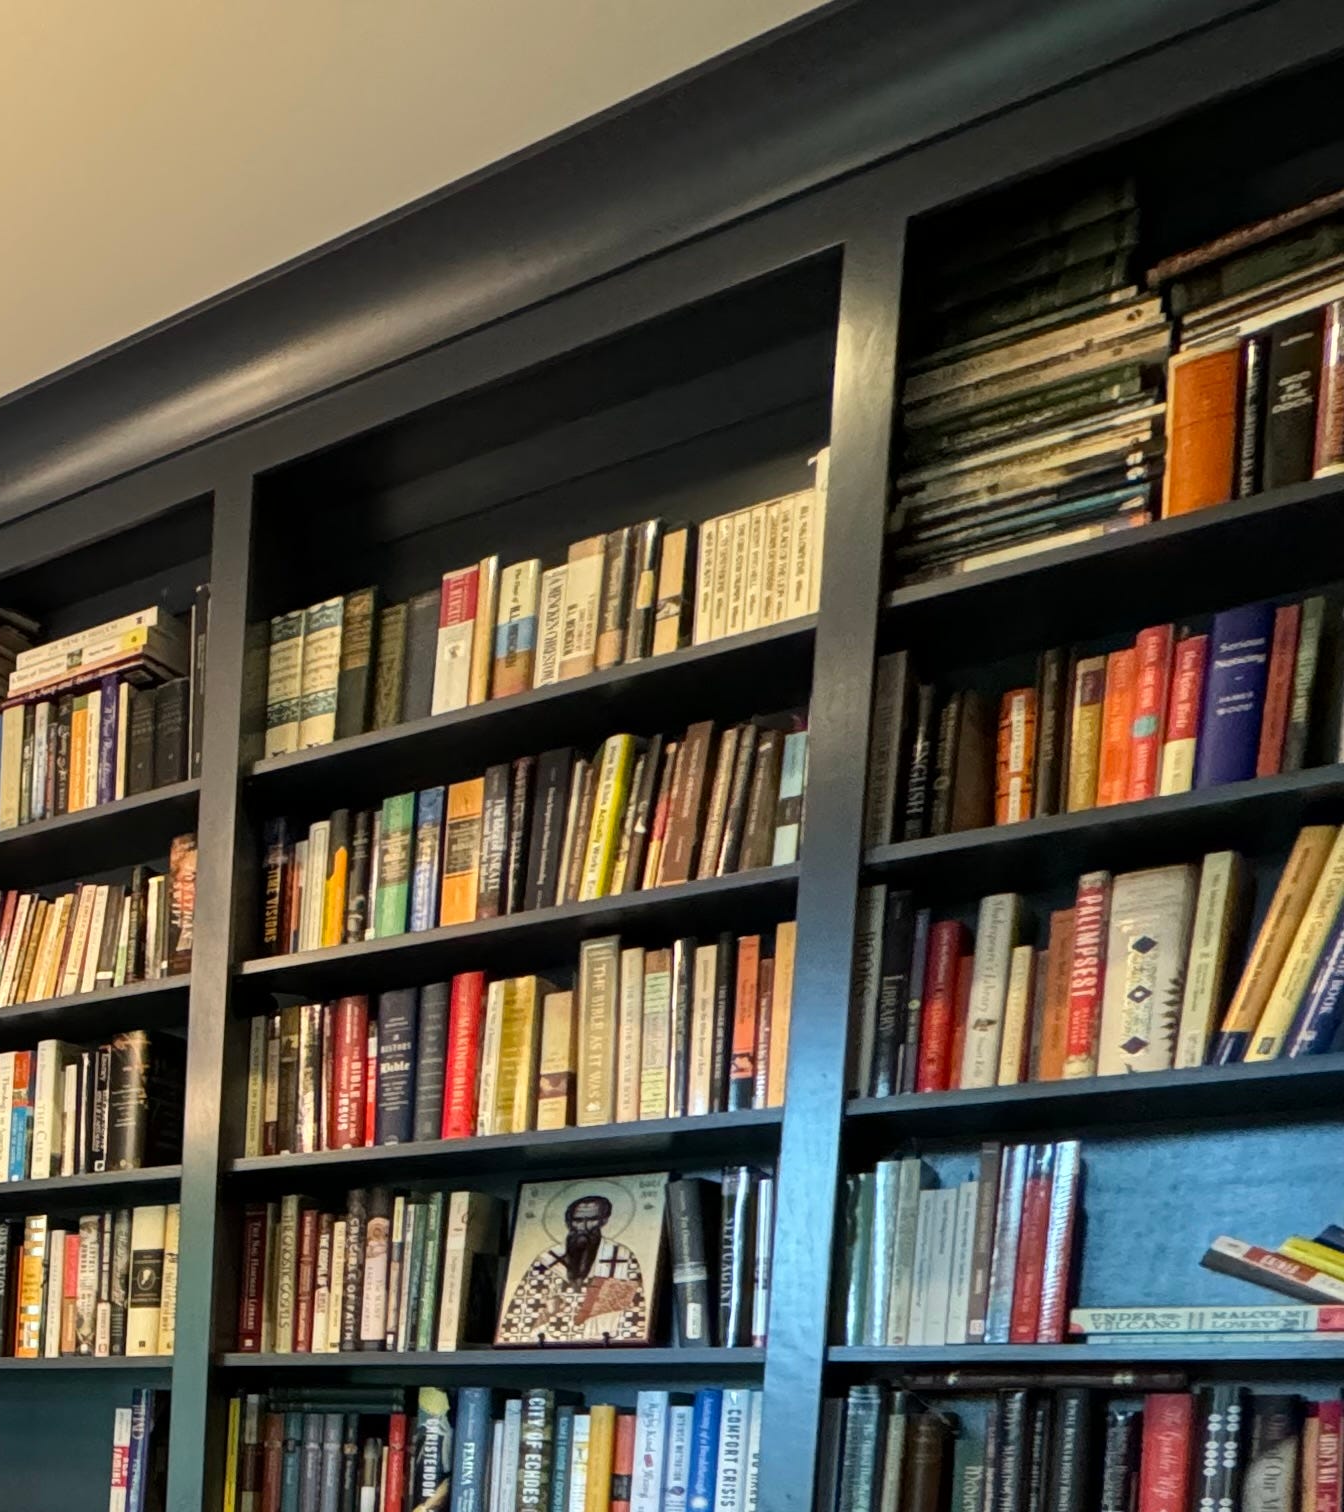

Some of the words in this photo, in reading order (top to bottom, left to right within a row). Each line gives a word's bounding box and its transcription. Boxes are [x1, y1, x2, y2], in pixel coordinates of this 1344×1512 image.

[1215, 652, 1266, 670] Noticing
[1220, 637, 1266, 654] Serious
[906, 738, 930, 816] ENGLISH
[170, 880, 183, 928] SWIFT
[180, 869, 197, 940] JONATHAN
[265, 899, 278, 943] VISIONS
[1070, 894, 1102, 997] PALIMPSEST
[591, 963, 606, 990] THE
[589, 993, 605, 1029] BIBLE
[455, 1015, 470, 1068] MAKING
[589, 1034, 601, 1050] AS
[381, 1061, 412, 1074] Bible
[588, 1054, 601, 1068] IT
[350, 1061, 362, 1099] BIBLE
[451, 1075, 466, 1113] BIBLE
[587, 1071, 600, 1098] WAS
[346, 1217, 361, 1280] CRUCIBLE
[345, 1284, 359, 1299] OF
[344, 1303, 358, 1340] FAITH
[1090, 1310, 1157, 1321] UNDER
[1090, 1320, 1181, 1332] VOLCANO
[1210, 1309, 1302, 1320] MALCOLM
[1211, 1320, 1274, 1332] LOWRY
[526, 1396, 545, 1429] CITY
[525, 1432, 543, 1449] OF
[724, 1407, 741, 1464] COMFORT
[421, 1417, 437, 1498] CHRISTENDOM
[460, 1442, 476, 1486] FEMINA
[522, 1452, 543, 1505] ECHOES
[721, 1467, 737, 1508] CRISIS
